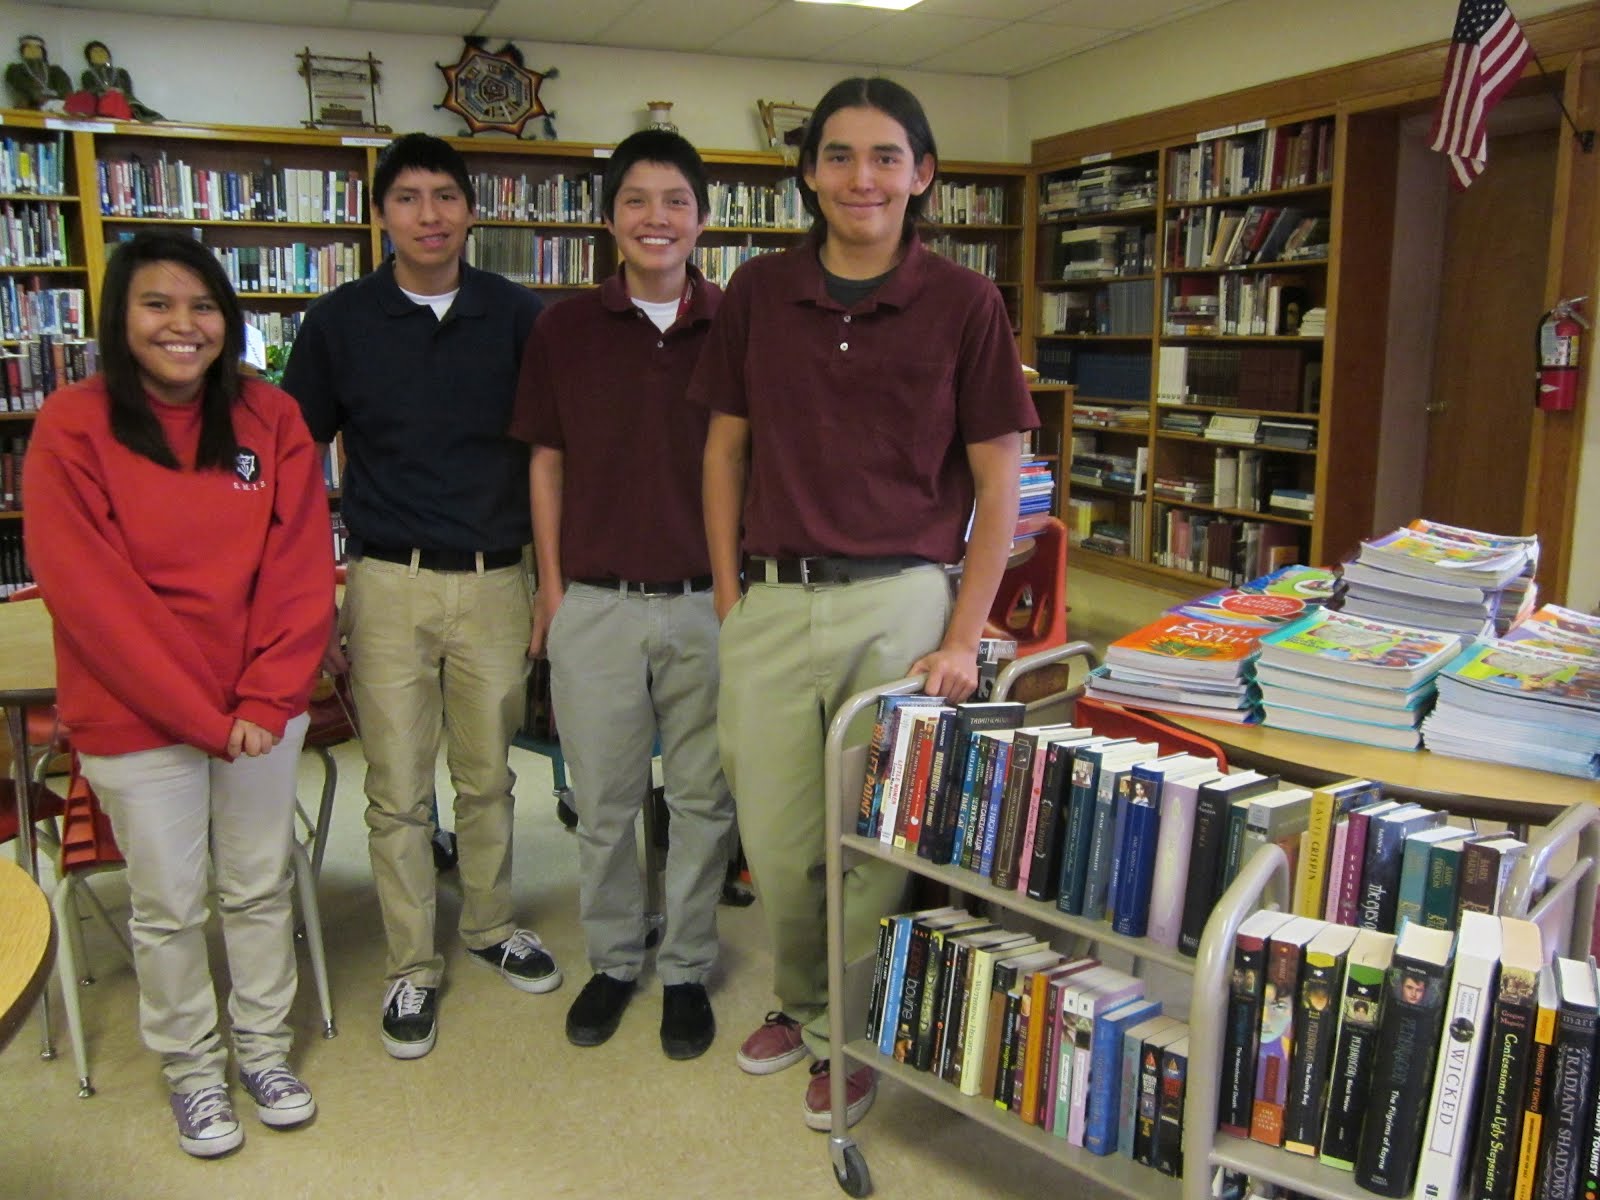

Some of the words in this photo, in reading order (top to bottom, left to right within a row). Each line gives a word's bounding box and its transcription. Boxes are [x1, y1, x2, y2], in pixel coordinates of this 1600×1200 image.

[869, 723, 883, 774] BULLET
[966, 748, 976, 781] ALEXANDER
[859, 774, 875, 818] POINT
[890, 783, 899, 804] WOMEN
[960, 791, 969, 811] TIME
[957, 813, 966, 829] CAT
[987, 812, 996, 832] HIGH
[983, 833, 994, 855] KING
[1307, 841, 1320, 880] CRISPIN
[900, 977, 920, 1020] bovine
[1004, 1012, 1014, 1044] wuthering
[1001, 1045, 1010, 1069] heights
[1496, 1032, 1518, 1095] Confessions
[1535, 1044, 1545, 1075] MISSING
[1233, 1057, 1241, 1083] Merchant
[1533, 1077, 1541, 1085] IN
[1302, 1074, 1311, 1093] Reality
[1439, 1047, 1463, 1126] WICKED
[1560, 1055, 1579, 1125] RADIANT
[1342, 1094, 1350, 1112] Water
[1389, 1089, 1399, 1104] The
[1496, 1095, 1507, 1104] of
[1530, 1087, 1540, 1111] TOKYO
[1382, 1105, 1396, 1135] Pilgrims
[1489, 1115, 1507, 1140] Ugly
[1381, 1136, 1390, 1145] of
[1376, 1146, 1388, 1169] Rayne
[1484, 1139, 1504, 1191] Stepsister
[1550, 1127, 1572, 1199] SHADOWS
[1589, 1135, 1600, 1177] TOURIST
